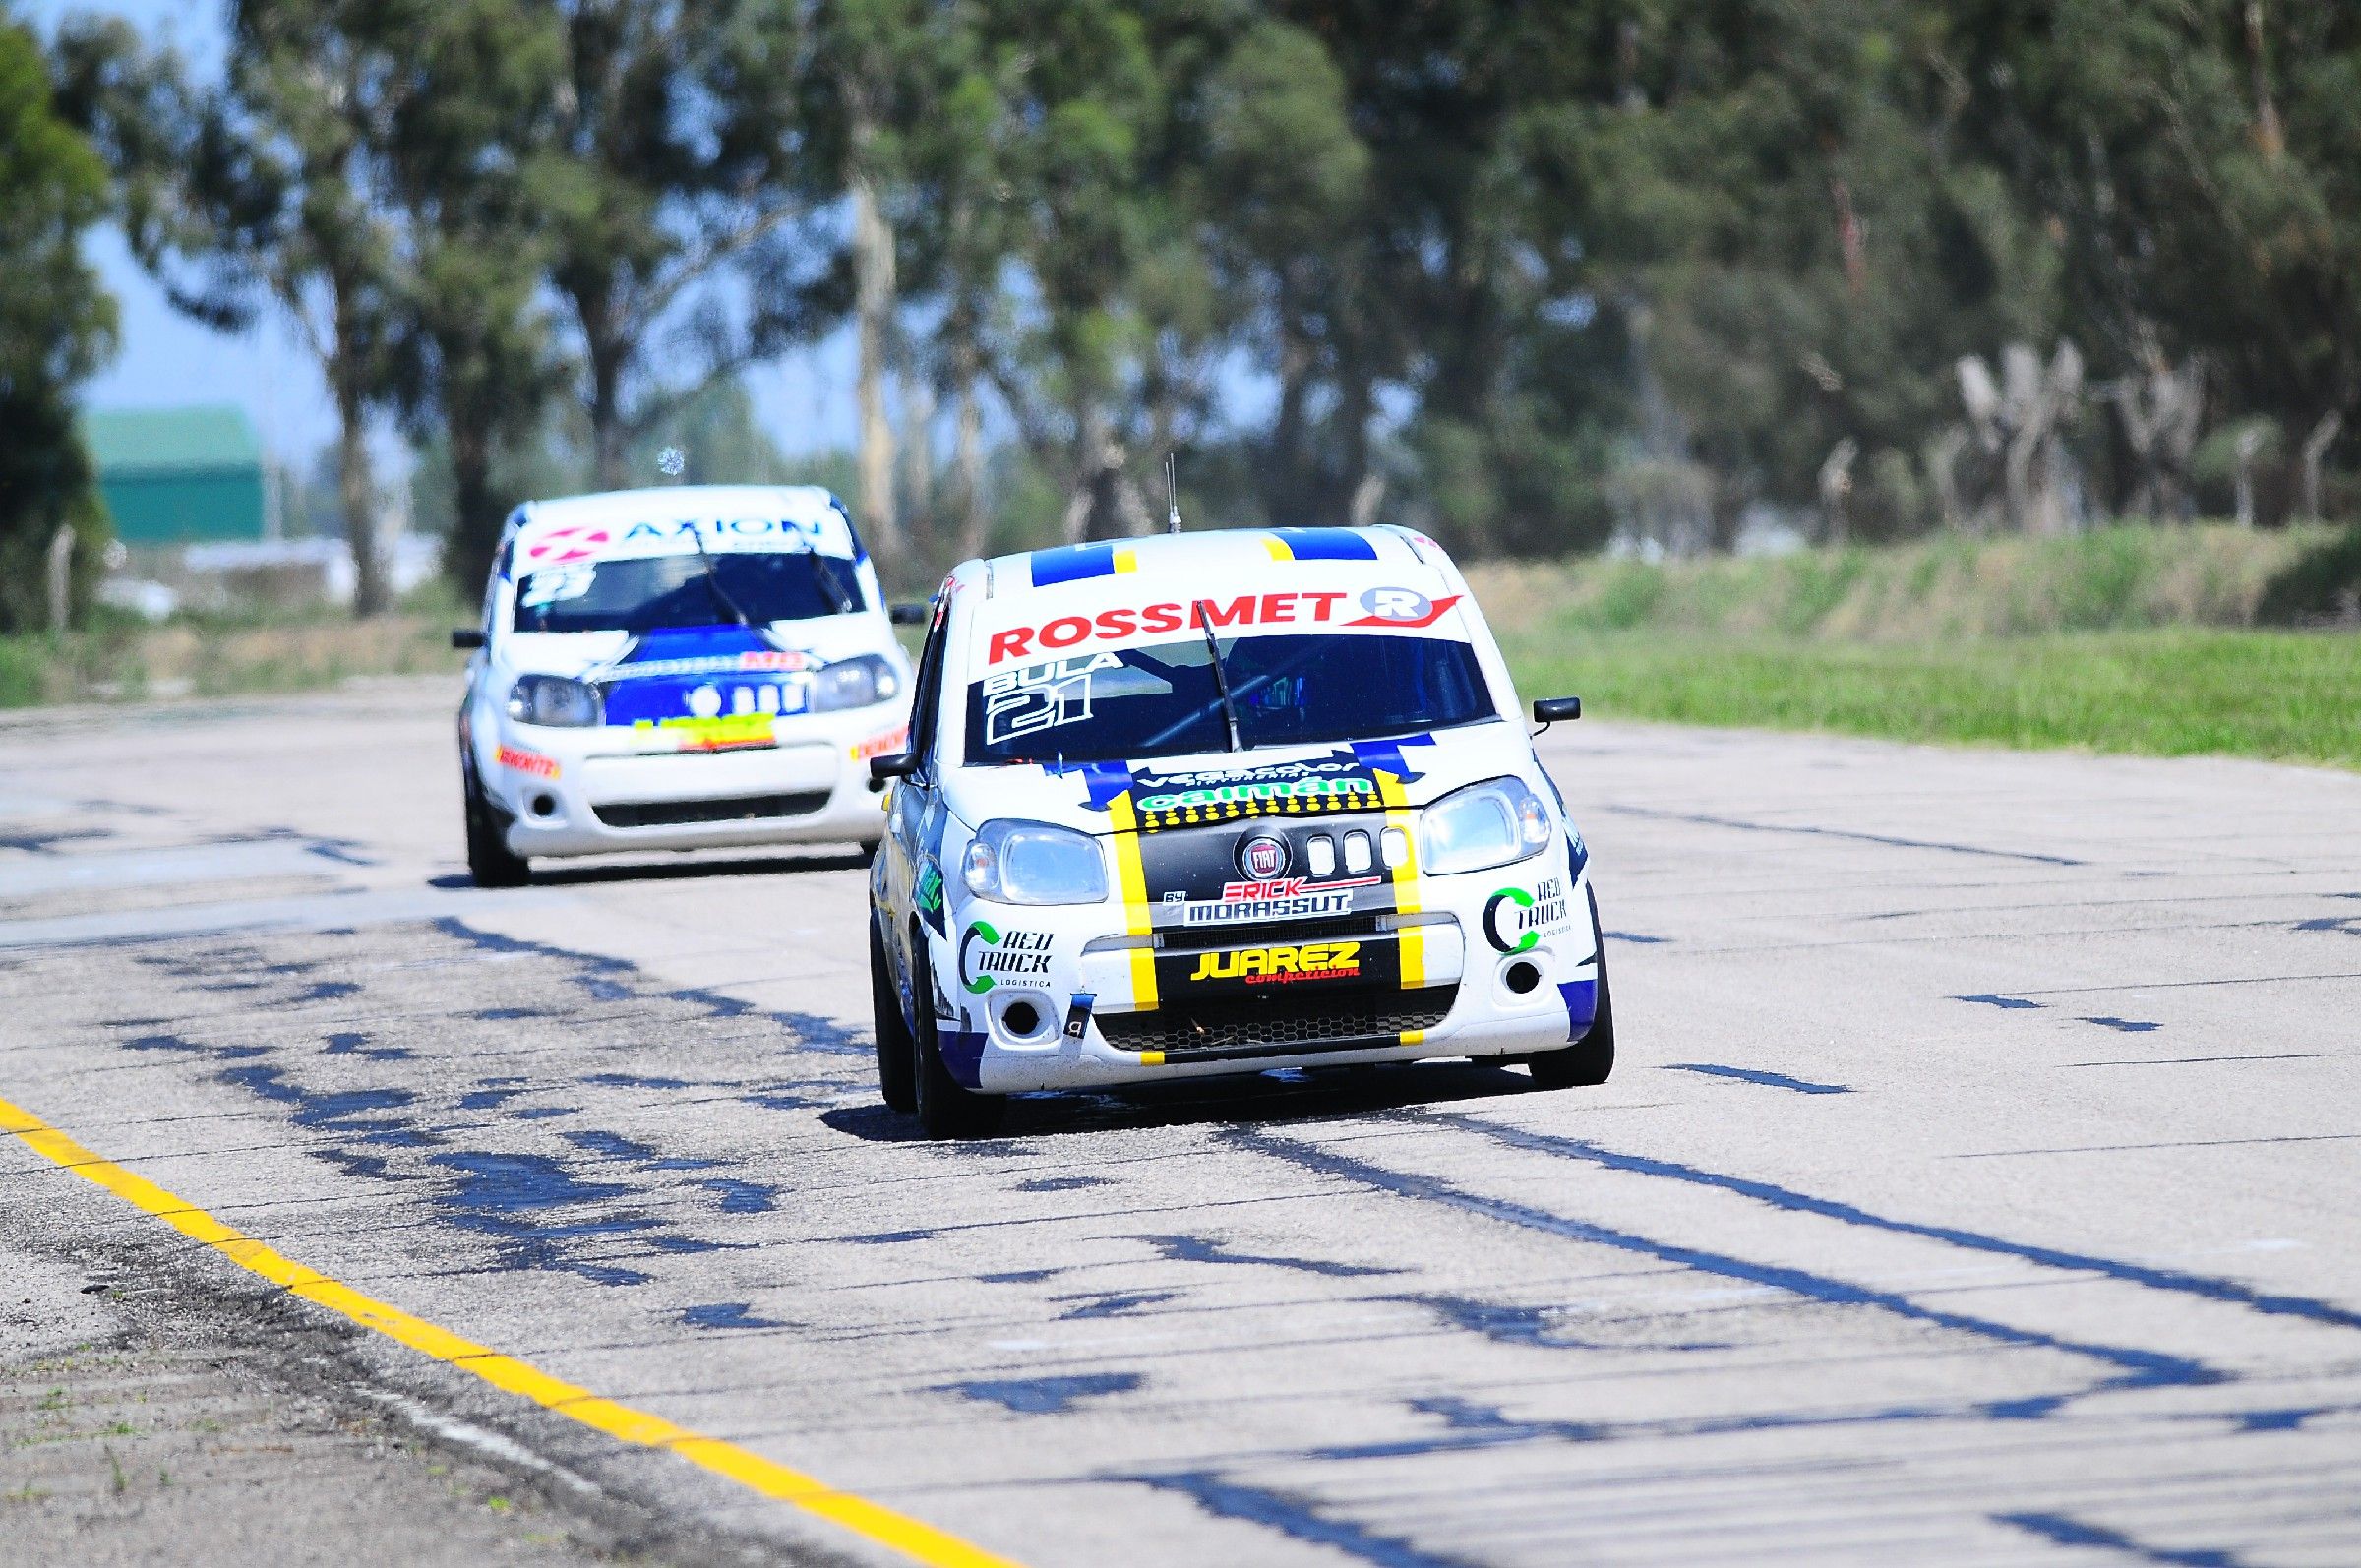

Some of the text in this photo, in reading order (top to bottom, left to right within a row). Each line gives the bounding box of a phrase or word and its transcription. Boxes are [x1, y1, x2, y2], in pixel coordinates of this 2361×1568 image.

[624, 519, 820, 540] AXION
[989, 592, 1347, 665] ROSSMET
[983, 651, 1124, 697] BULA
[986, 674, 1094, 746] 21
[1252, 849, 1276, 871] FIAT
[1224, 879, 1306, 902] ERICK
[1189, 894, 1349, 922] MORASSUT
[1514, 899, 1567, 930] TRUCK
[978, 950, 1053, 974] TRUCK
[1190, 942, 1360, 981] JUAREZ
[1000, 979, 1051, 988] LOGISTICA
